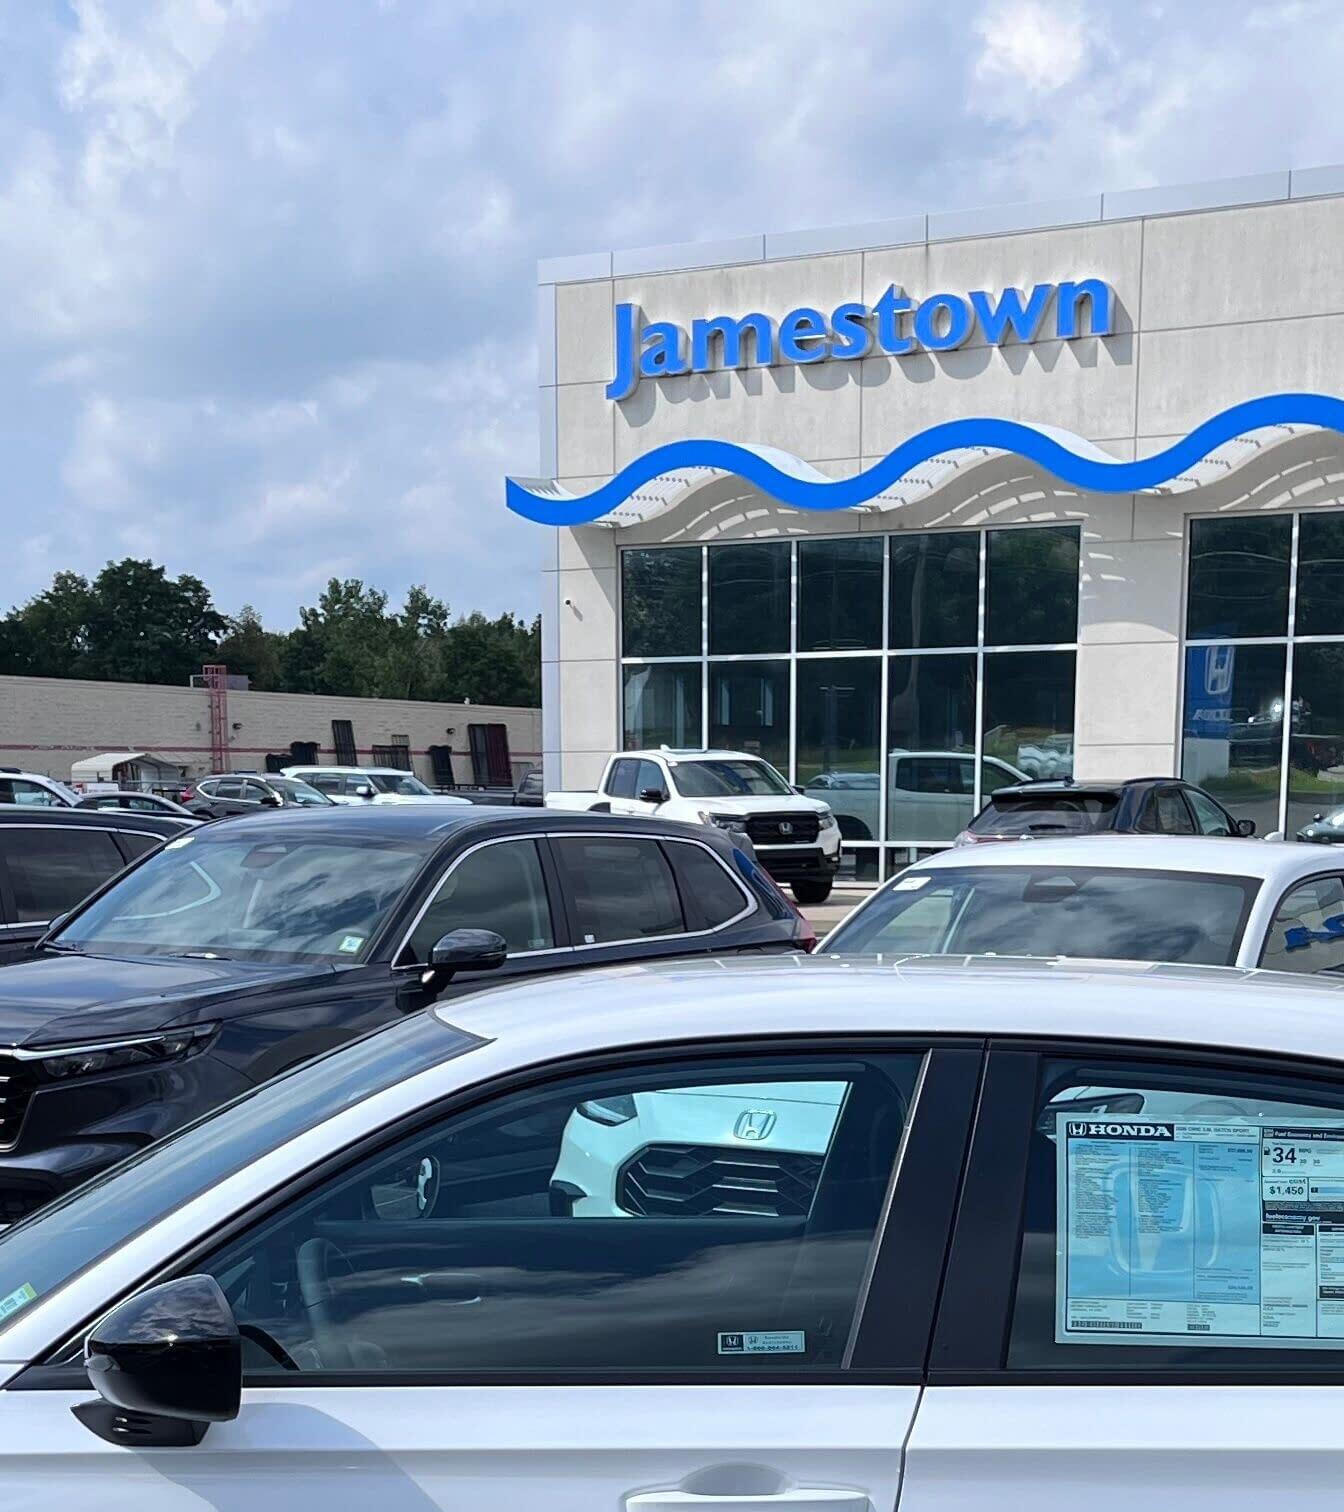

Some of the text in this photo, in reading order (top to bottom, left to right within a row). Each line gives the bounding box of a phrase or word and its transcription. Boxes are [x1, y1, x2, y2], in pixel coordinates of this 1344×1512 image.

[606, 278, 1116, 401] Jamestown
[1089, 1124, 1172, 1137] HONDA
[1272, 1147, 1297, 1164] 34
[1269, 1186, 1304, 1195] $1,450
